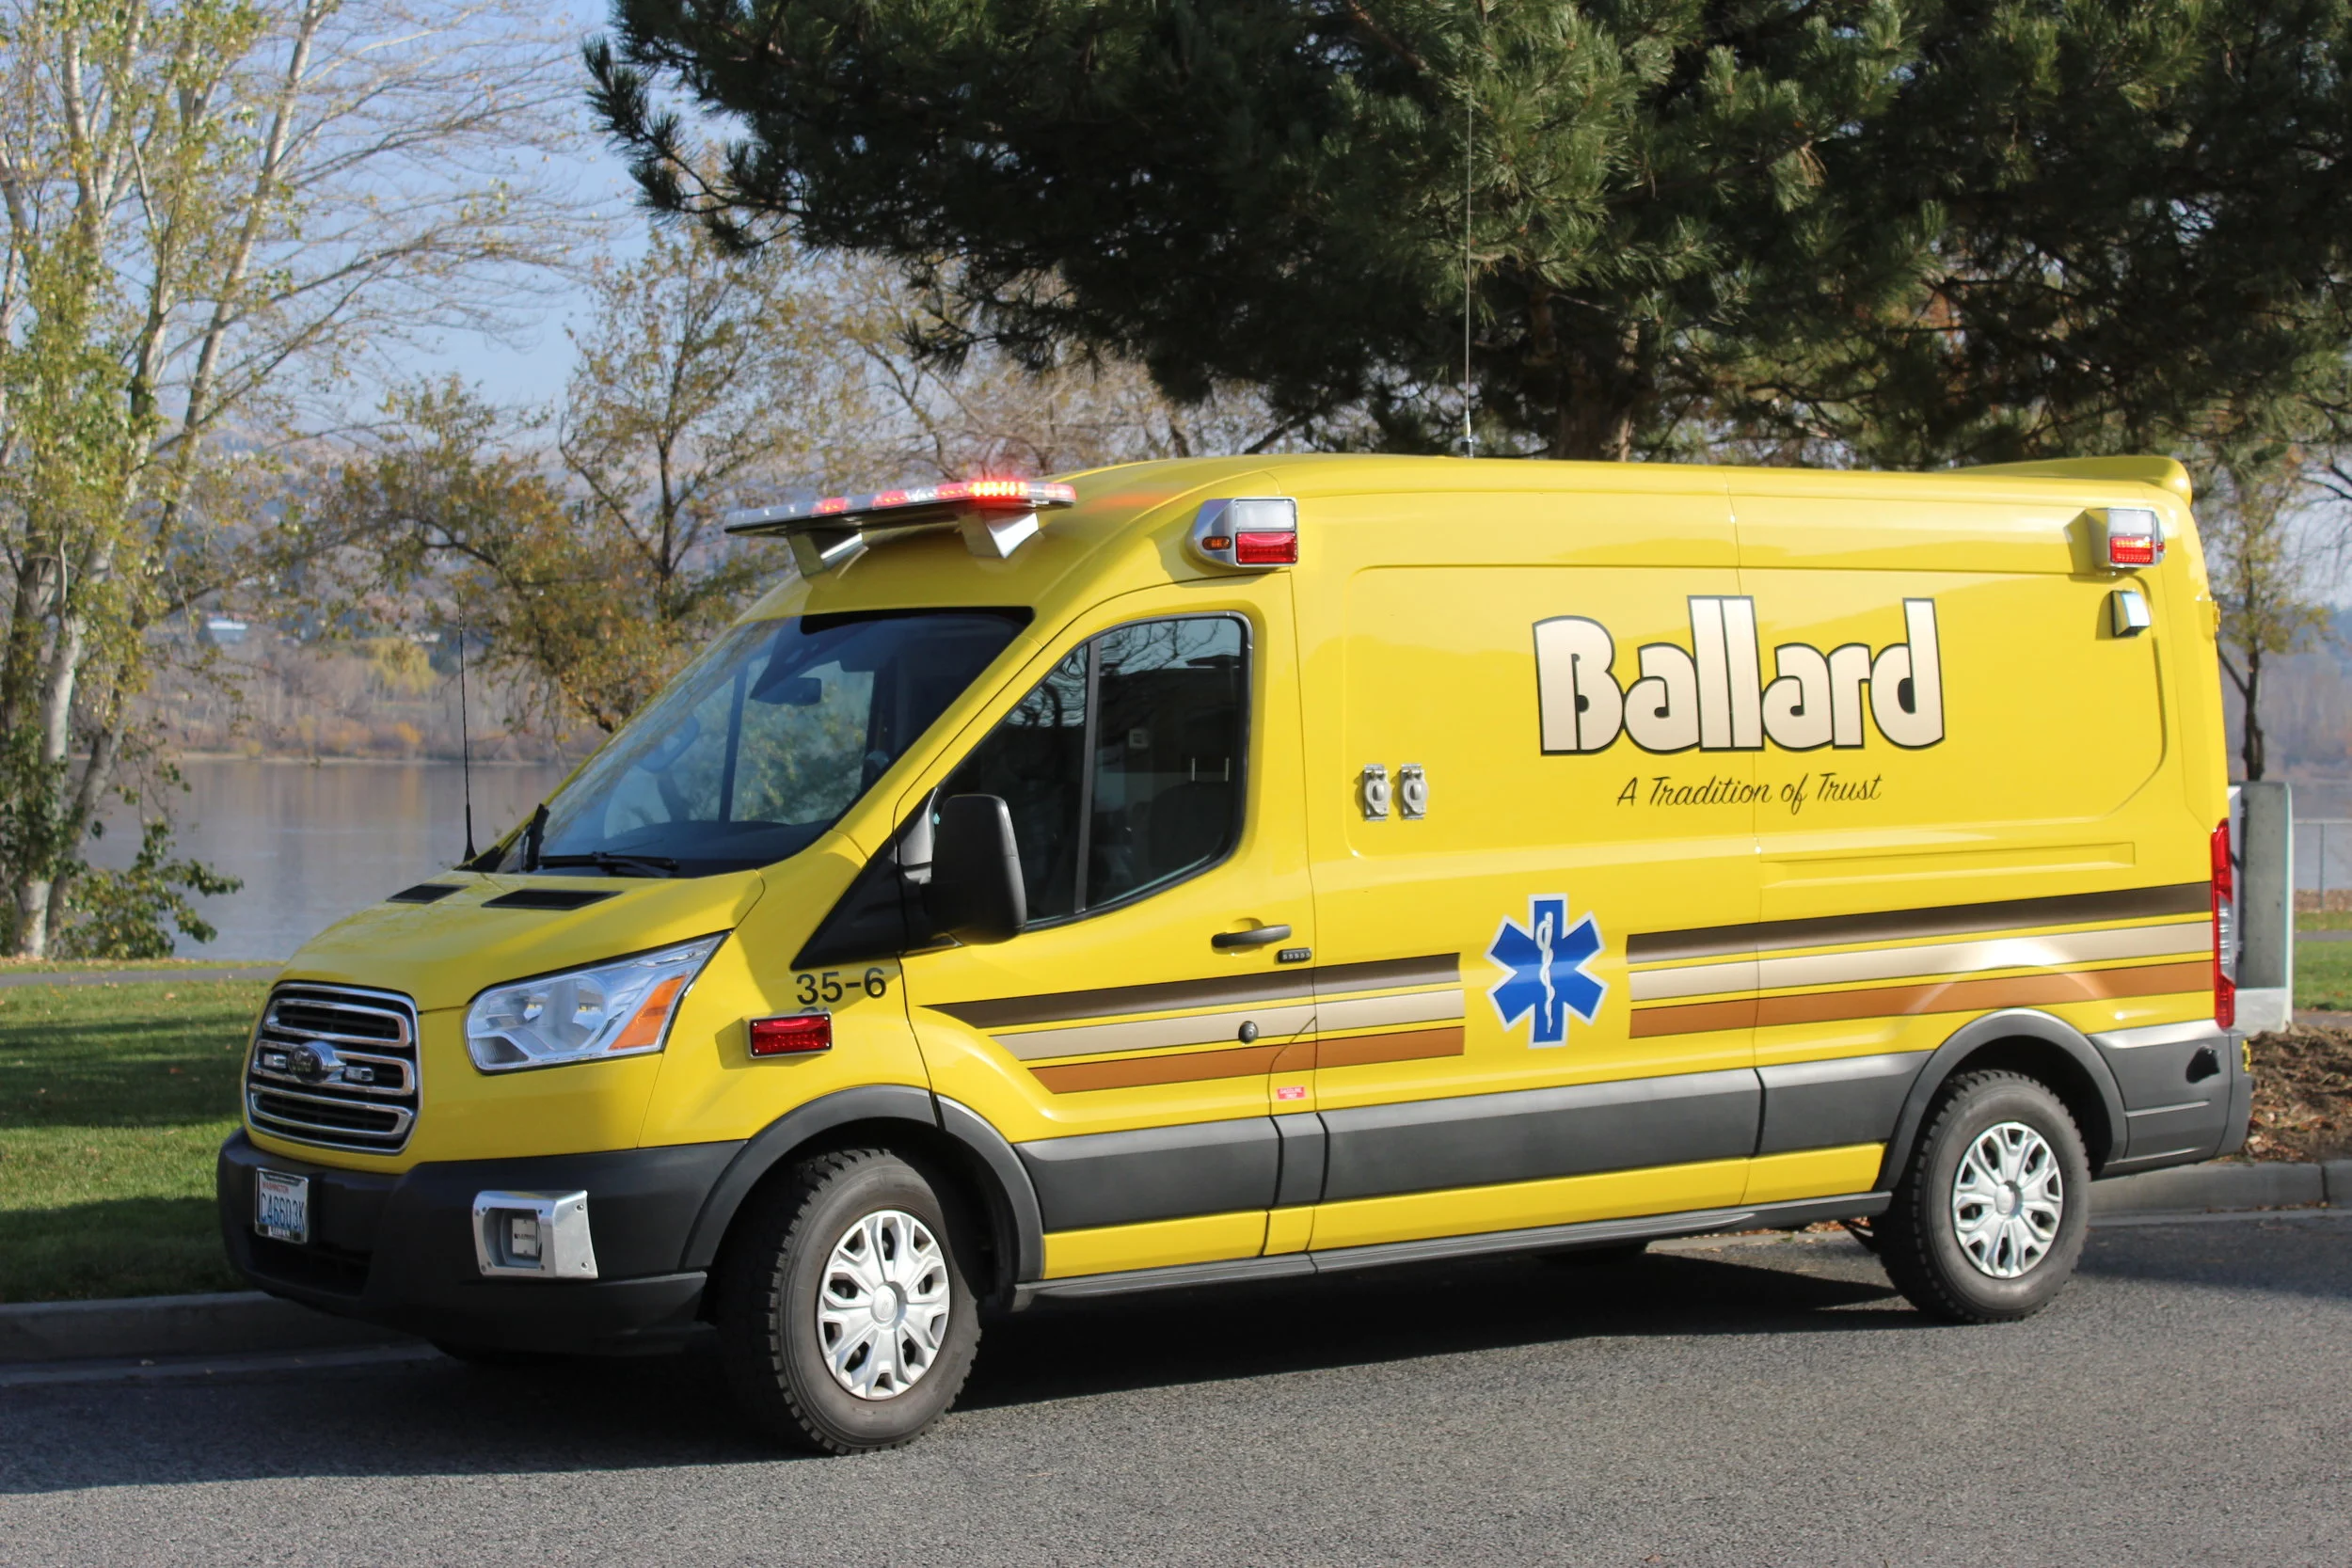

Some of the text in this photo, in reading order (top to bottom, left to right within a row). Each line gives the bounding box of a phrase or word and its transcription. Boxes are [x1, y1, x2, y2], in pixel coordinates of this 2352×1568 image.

[1532, 595, 1946, 756] Ballard
[1616, 772, 1883, 816] A Tradition of Trust
[796, 967, 887, 1006] 35-6
